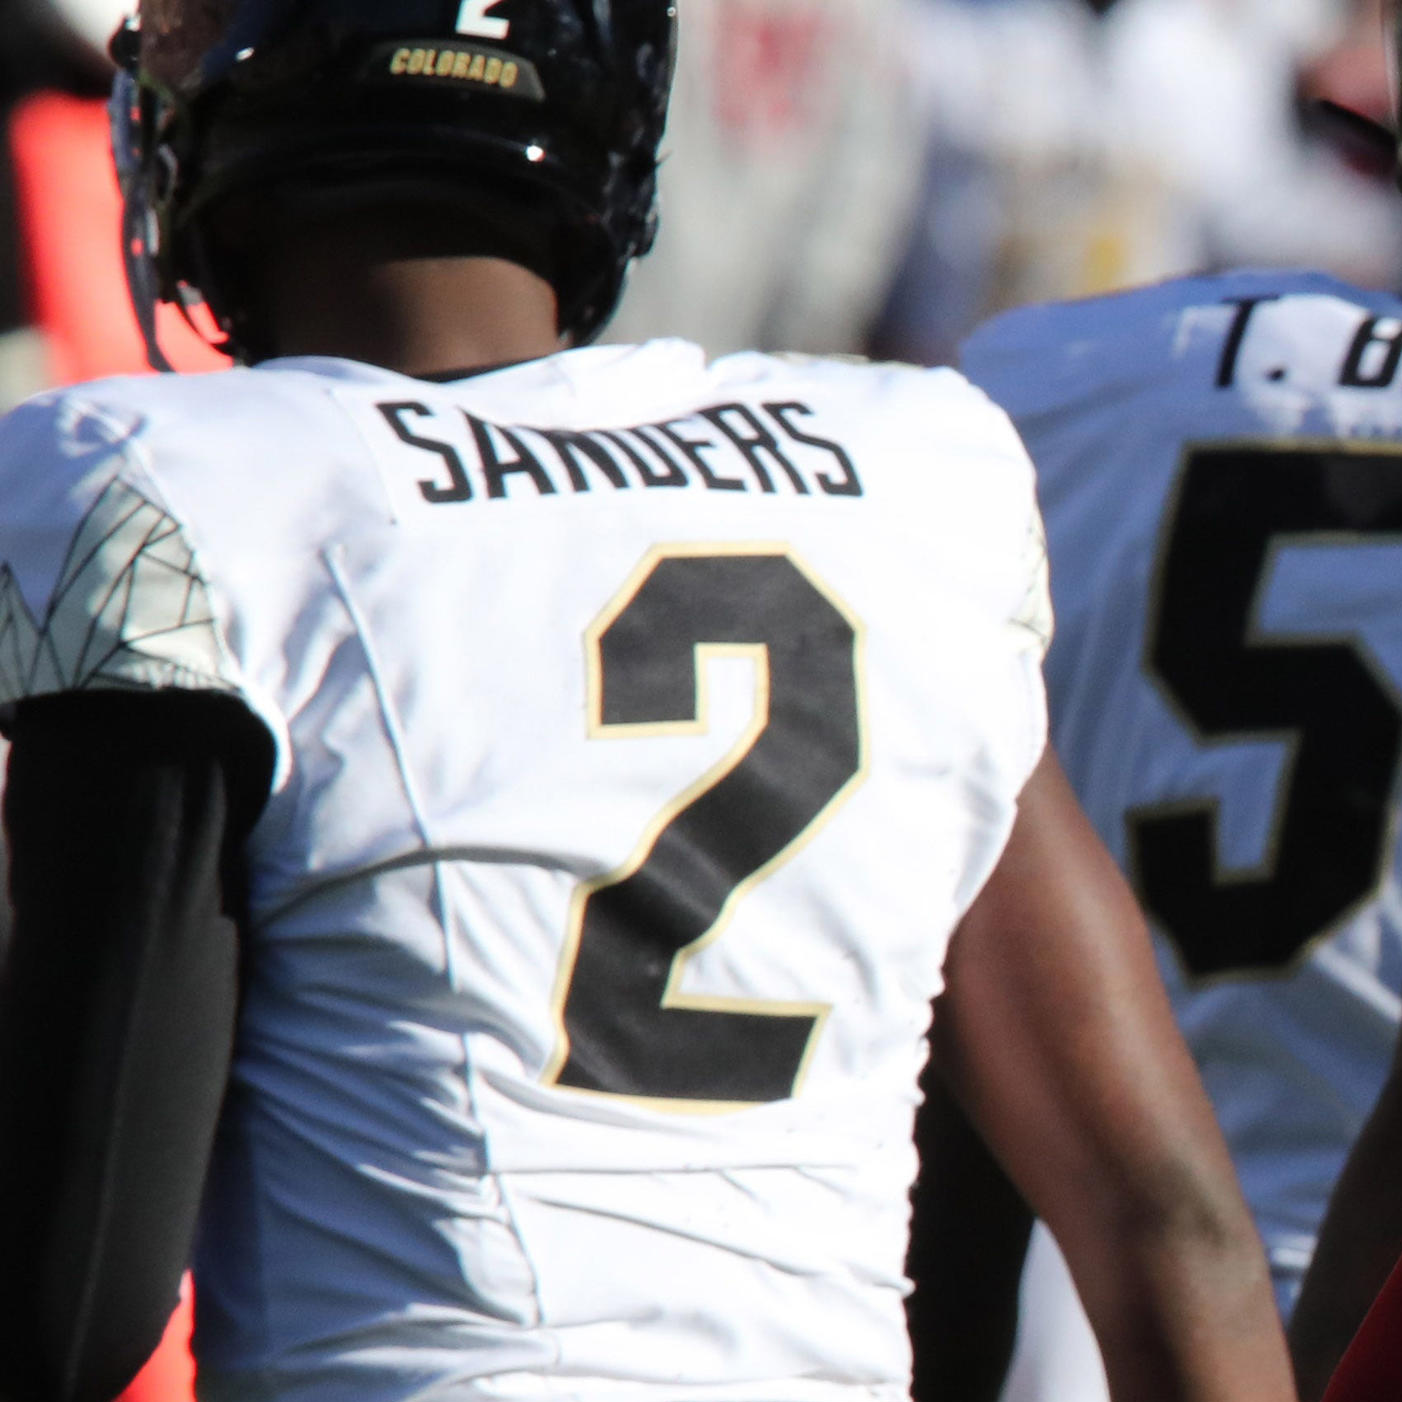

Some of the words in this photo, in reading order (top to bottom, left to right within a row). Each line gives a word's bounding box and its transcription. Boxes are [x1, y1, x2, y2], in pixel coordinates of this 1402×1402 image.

[389, 47, 519, 89] COLORADO
[1213, 293, 1290, 389] T.
[374, 400, 865, 504] SANDERS
[540, 541, 870, 1116] 2
